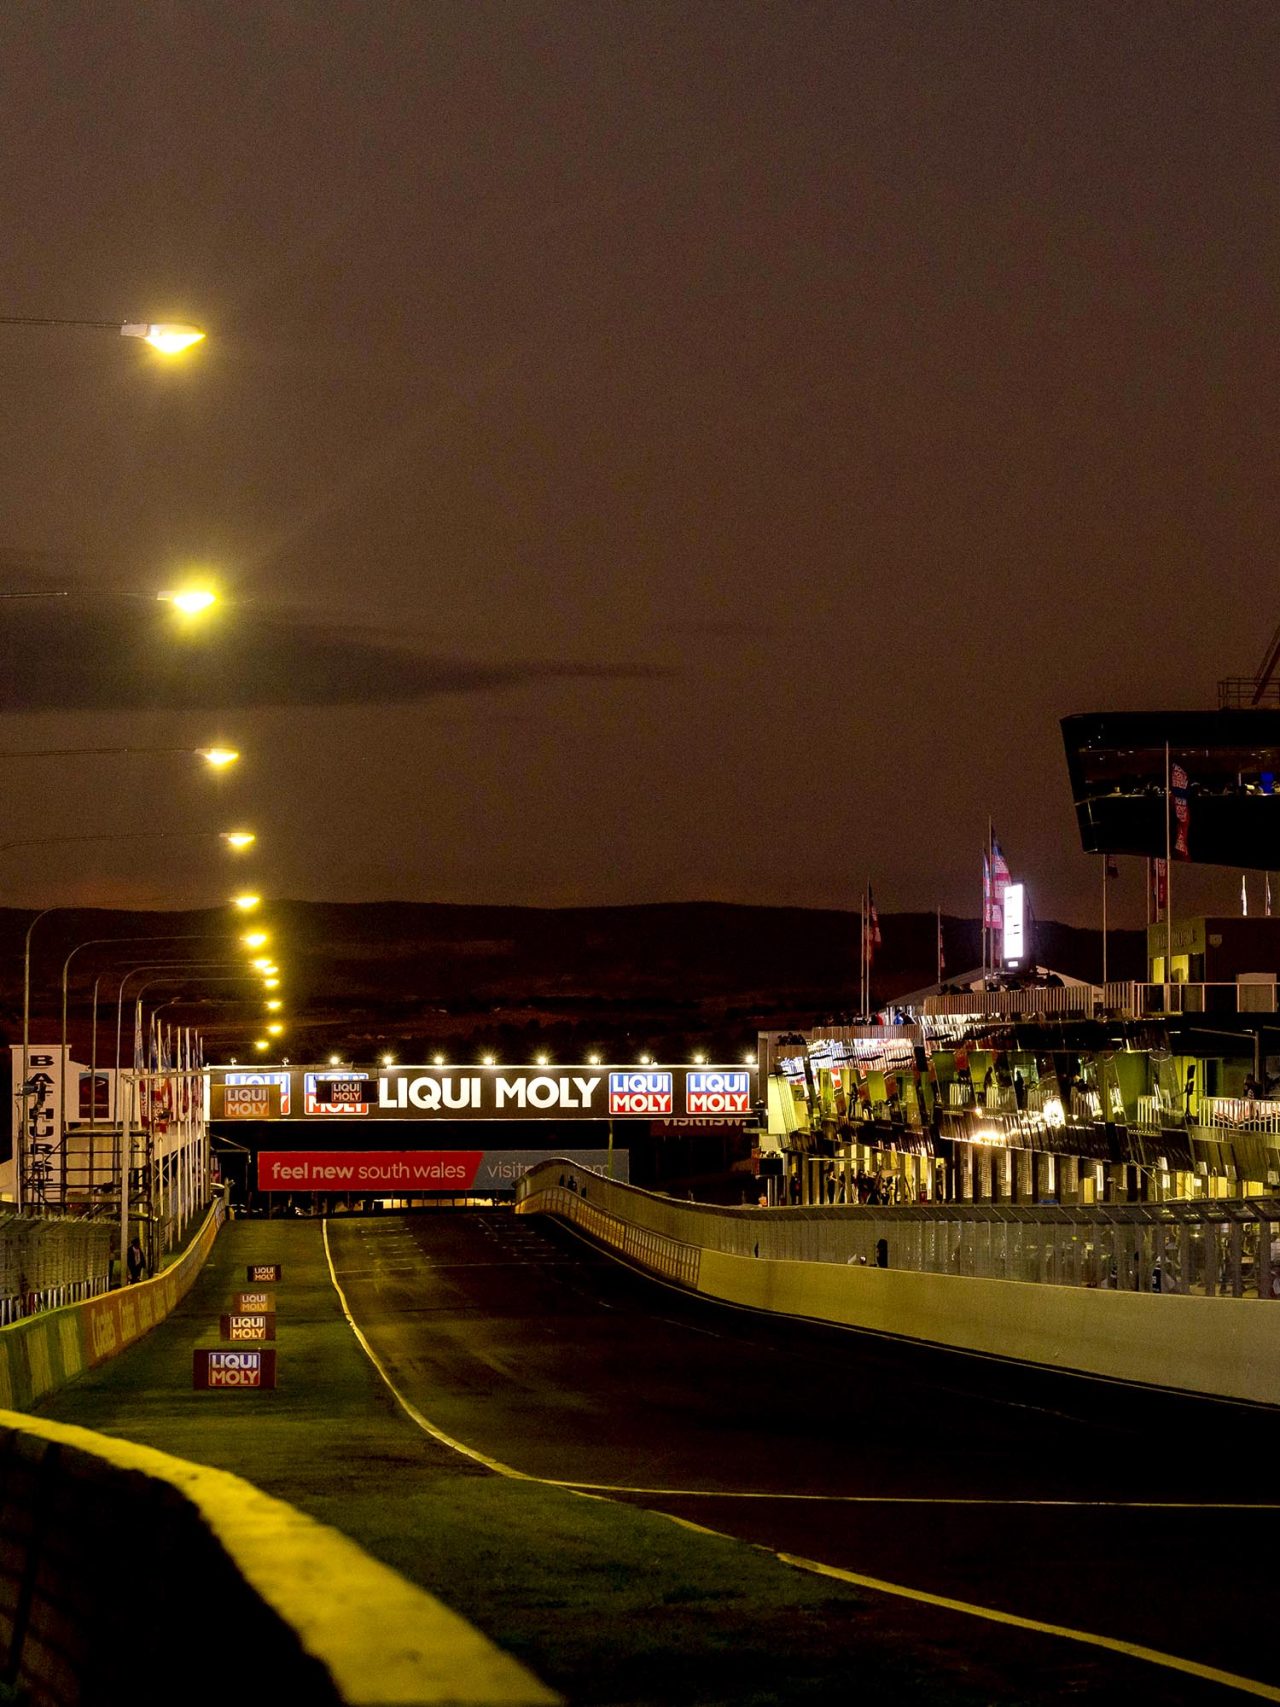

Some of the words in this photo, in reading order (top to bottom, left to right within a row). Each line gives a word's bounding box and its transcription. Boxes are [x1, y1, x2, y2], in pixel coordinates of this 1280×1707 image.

[333, 1083, 360, 1093] LIQUI
[613, 1074, 669, 1093] LIQUI
[691, 1074, 746, 1093] LIQUI
[228, 1089, 266, 1102] LIQUI
[333, 1093, 361, 1101] MOLY
[379, 1076, 481, 1110] LIQUI
[500, 1077, 601, 1108] MOLY
[227, 1103, 268, 1115] MOLY
[613, 1094, 671, 1111] MOLY
[690, 1094, 747, 1112] MOLY
[271, 1162, 309, 1179] feel
[312, 1165, 353, 1179] new
[358, 1162, 410, 1179] south
[414, 1162, 466, 1179] wales
[242, 1295, 266, 1303] LIQUI
[242, 1303, 267, 1311] MOLY
[232, 1318, 264, 1328] LIQUI
[232, 1329, 264, 1338] MOLY
[211, 1355, 257, 1369] LIQUI
[211, 1371, 258, 1384] MOLY
